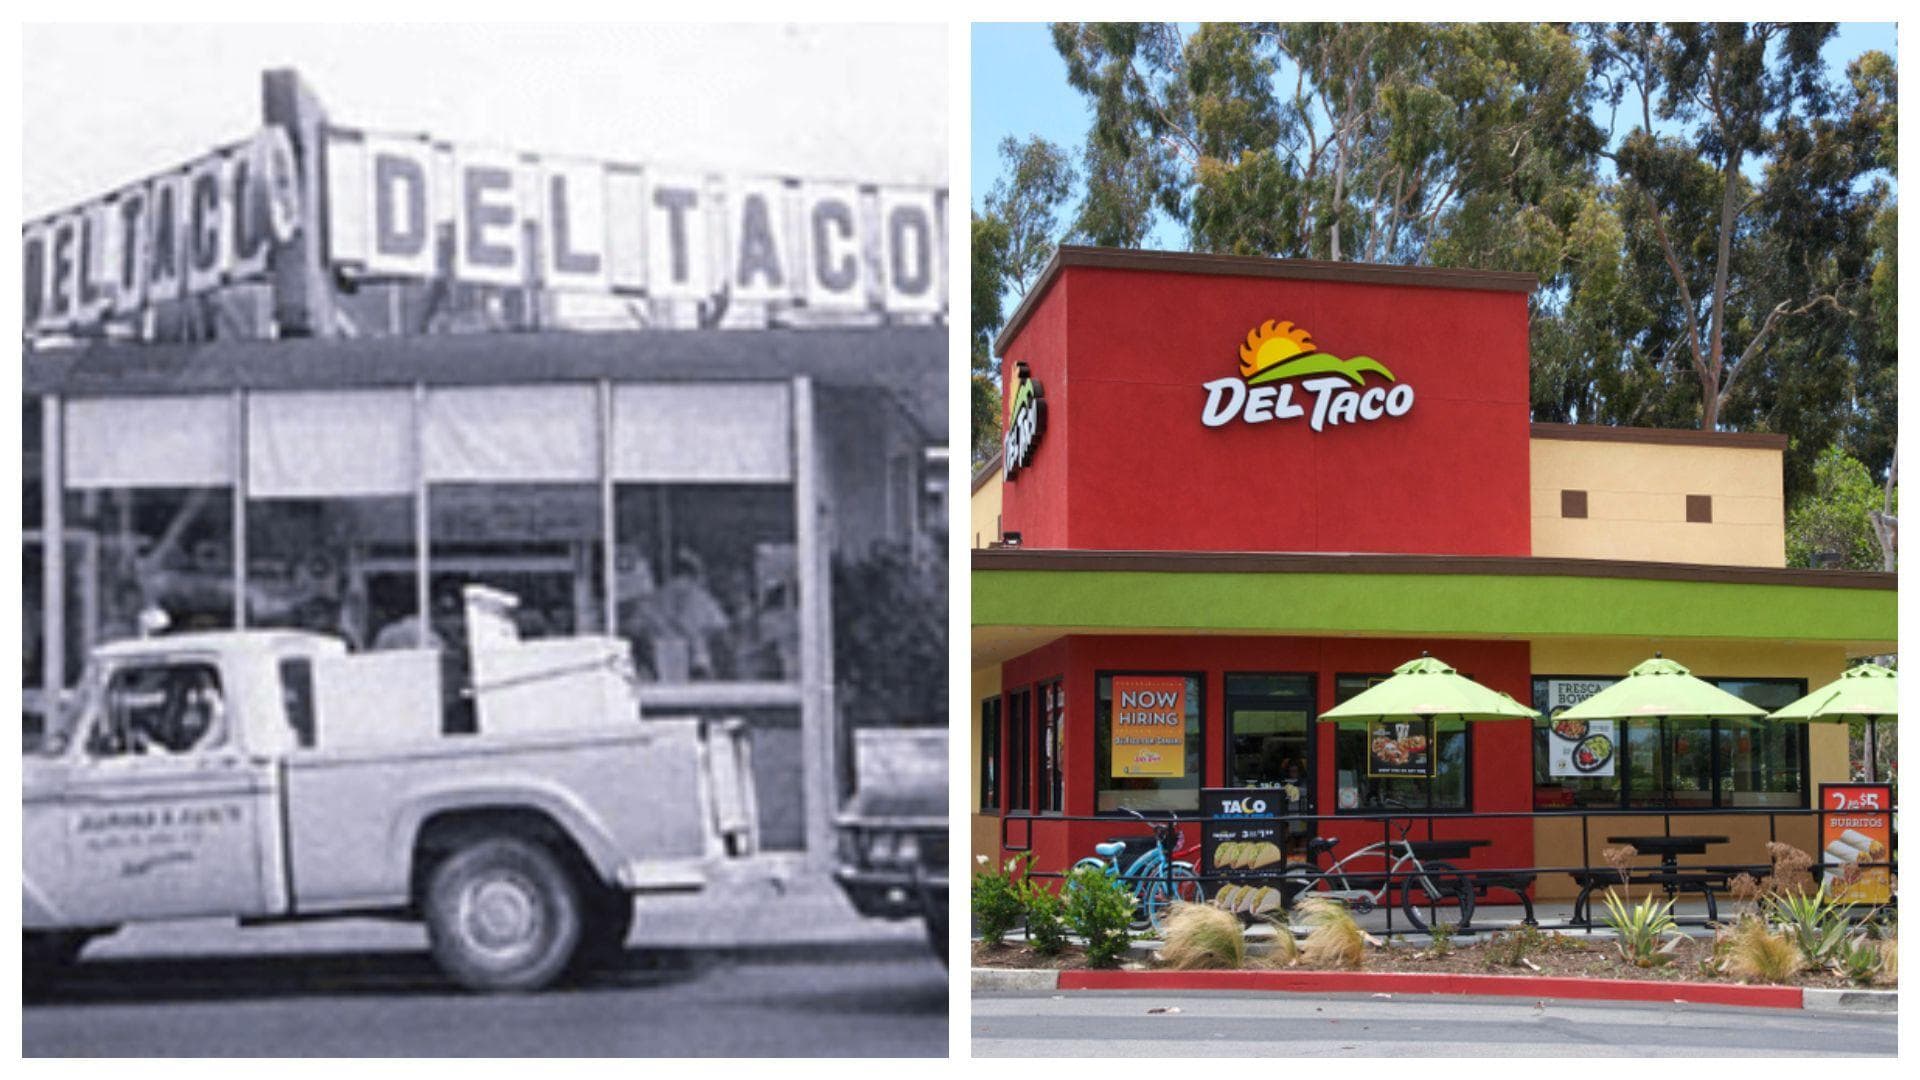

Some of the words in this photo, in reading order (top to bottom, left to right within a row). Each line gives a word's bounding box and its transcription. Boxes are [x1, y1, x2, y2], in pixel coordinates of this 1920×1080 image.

[374, 153, 602, 275] DEL
[652, 187, 933, 297] TACO
[1201, 376, 1304, 428] DEL
[1302, 377, 1415, 432] TACO
[1558, 683, 1602, 694] FRESCA
[1121, 691, 1178, 708] NOW
[1558, 694, 1594, 704] BOW
[1120, 712, 1178, 725] HIRING
[1221, 797, 1266, 814] TACO
[1832, 792, 1847, 814] 2
[1830, 818, 1884, 828] BURRITOS
